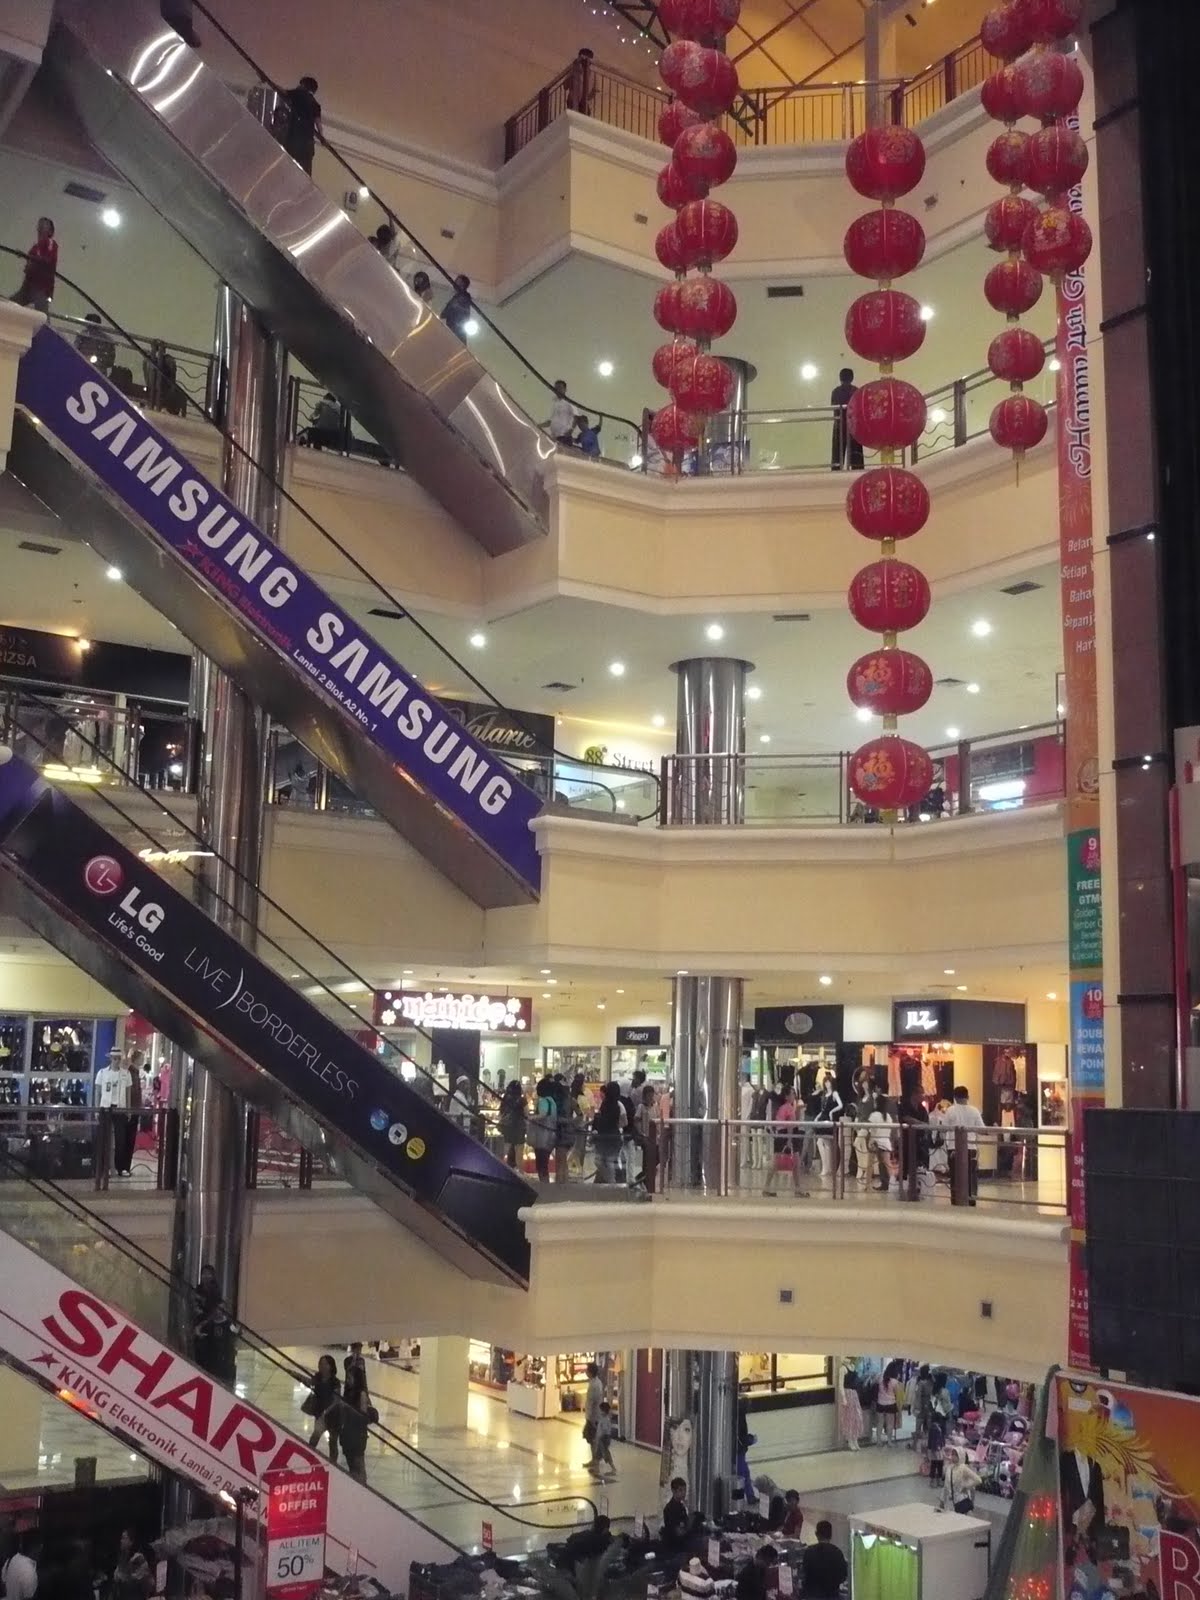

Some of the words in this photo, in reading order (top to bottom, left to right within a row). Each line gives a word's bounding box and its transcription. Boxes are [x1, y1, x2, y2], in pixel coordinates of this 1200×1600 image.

[66, 381, 299, 608] SAMSUNG
[306, 612, 512, 815] SAMSUNG
[0, 650, 37, 668] IZSA
[293, 649, 320, 676] Lantai
[318, 674, 327, 683] 2
[325, 680, 345, 701] Blok
[344, 699, 357, 712] A2
[355, 709, 369, 726] No.
[1088, 837, 1097, 851] 9
[1076, 879, 1100, 891] FREE
[119, 886, 165, 934] LG
[107, 912, 135, 938] Life's
[135, 935, 165, 962] Good
[1087, 989, 1102, 1001] 10
[56, 1365, 111, 1409] KING
[108, 1403, 178, 1457] Elektronik
[180, 1452, 215, 1481] Lantai
[212, 1475, 222, 1487] 2
[273, 1481, 324, 1496] SPECIAL
[278, 1499, 317, 1513] OFFER
